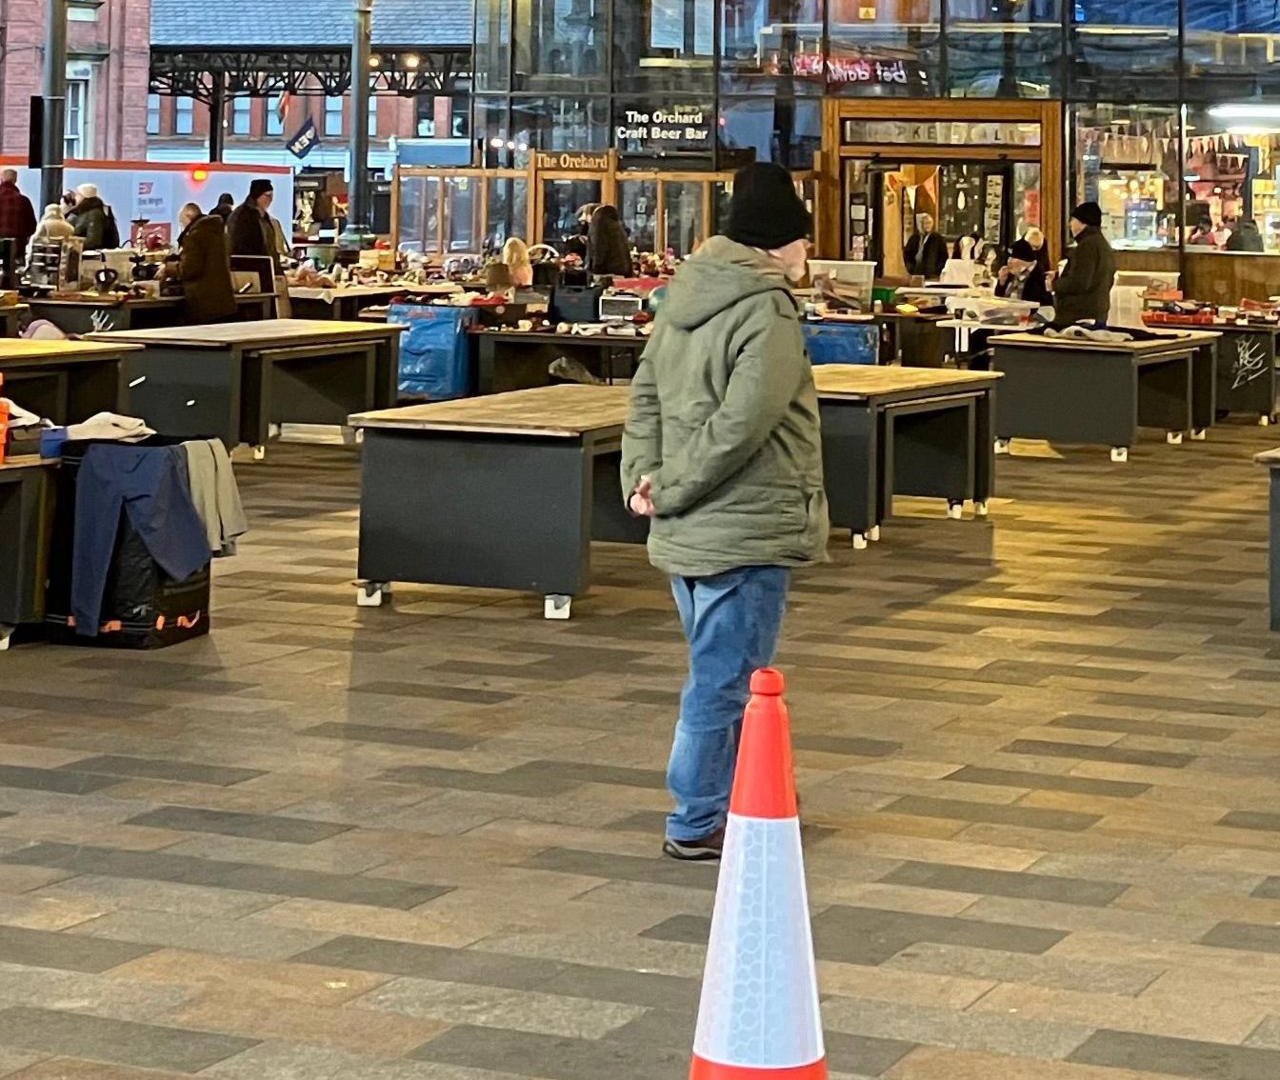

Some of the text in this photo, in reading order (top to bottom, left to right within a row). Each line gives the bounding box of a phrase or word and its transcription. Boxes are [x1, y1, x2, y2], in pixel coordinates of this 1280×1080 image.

[626, 111, 703, 124] The Orchard
[617, 127, 707, 139] Craft Beer Bar
[537, 154, 608, 169] The Orchard
